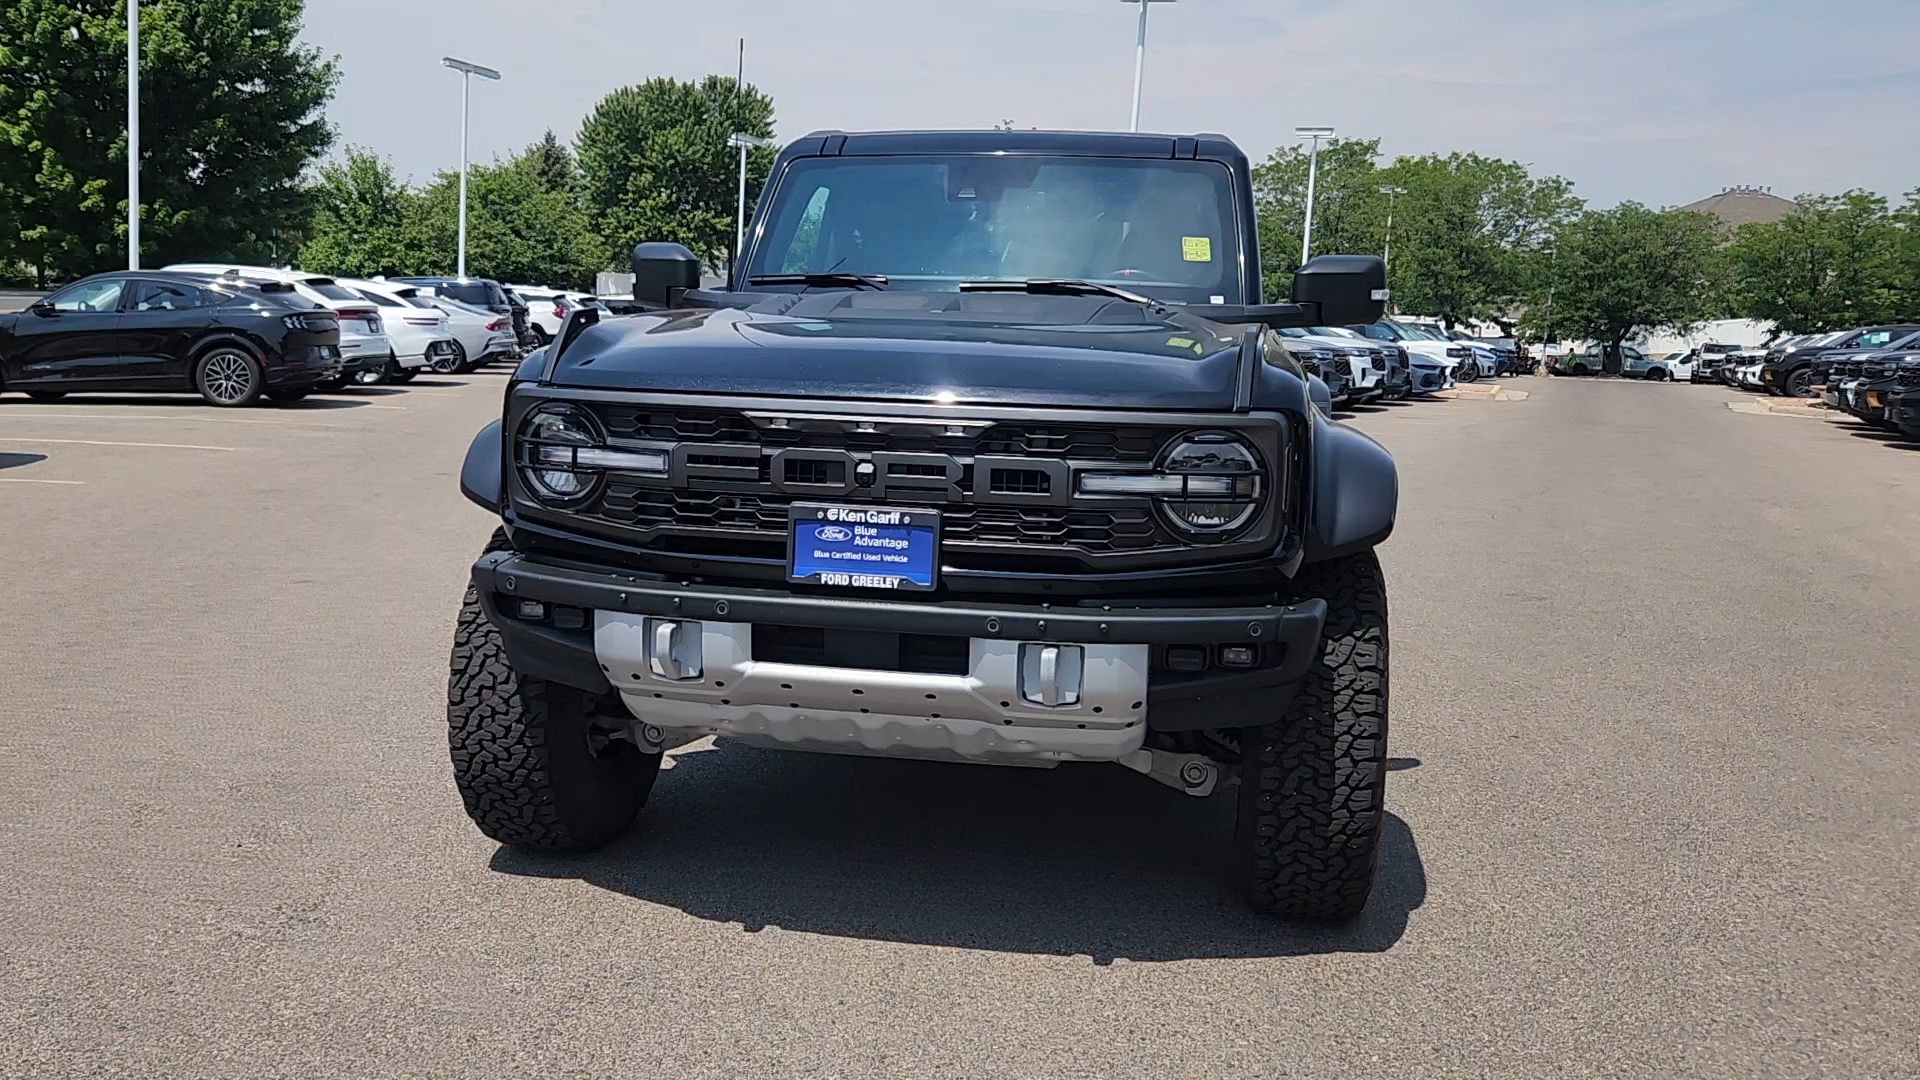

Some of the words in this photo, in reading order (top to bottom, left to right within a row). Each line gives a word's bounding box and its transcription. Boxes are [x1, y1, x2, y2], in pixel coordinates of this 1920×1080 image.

[674, 442, 1069, 504] FORD
[839, 509, 866, 522] Ken
[867, 511, 901, 525] Garff
[821, 527, 846, 540] Ford
[854, 525, 878, 536] Blue
[853, 537, 909, 550] Advantage
[813, 550, 830, 558] Blue
[831, 551, 862, 560] Certified
[862, 553, 881, 561] Used
[882, 555, 909, 563] Vehicle
[820, 573, 850, 586] FORD
[851, 575, 901, 589] GREELEY
